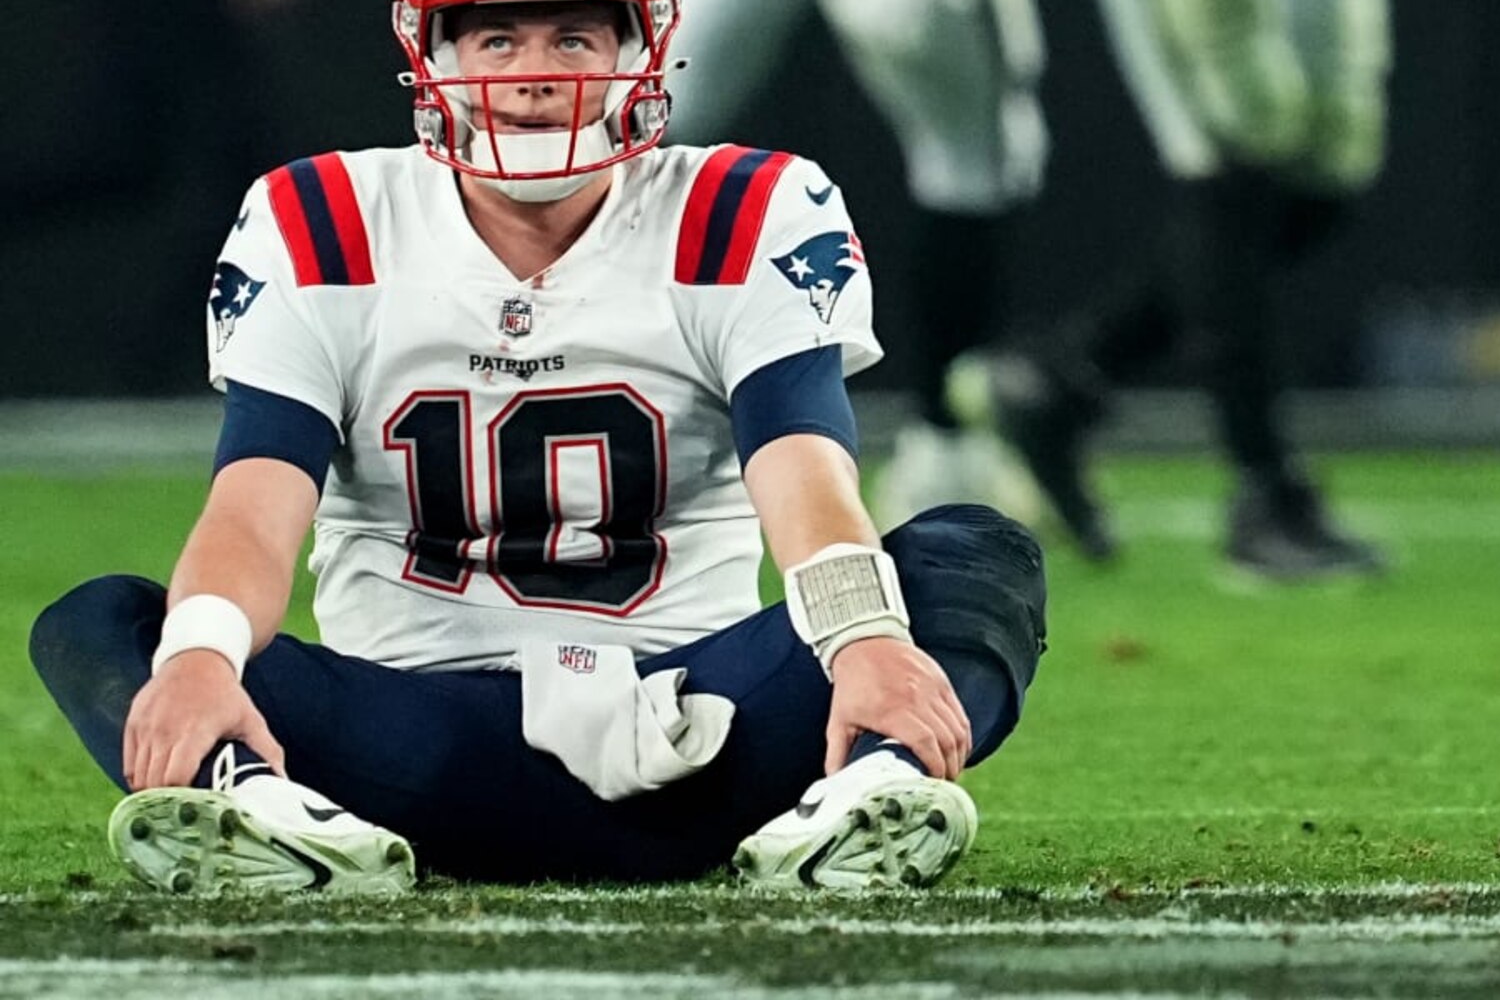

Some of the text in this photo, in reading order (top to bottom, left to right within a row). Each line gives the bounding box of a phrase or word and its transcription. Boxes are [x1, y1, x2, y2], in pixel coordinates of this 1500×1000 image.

[505, 314, 529, 331] NFL
[469, 354, 565, 373] PATRIOTS
[383, 383, 667, 617] 10
[562, 652, 593, 669] NFL
